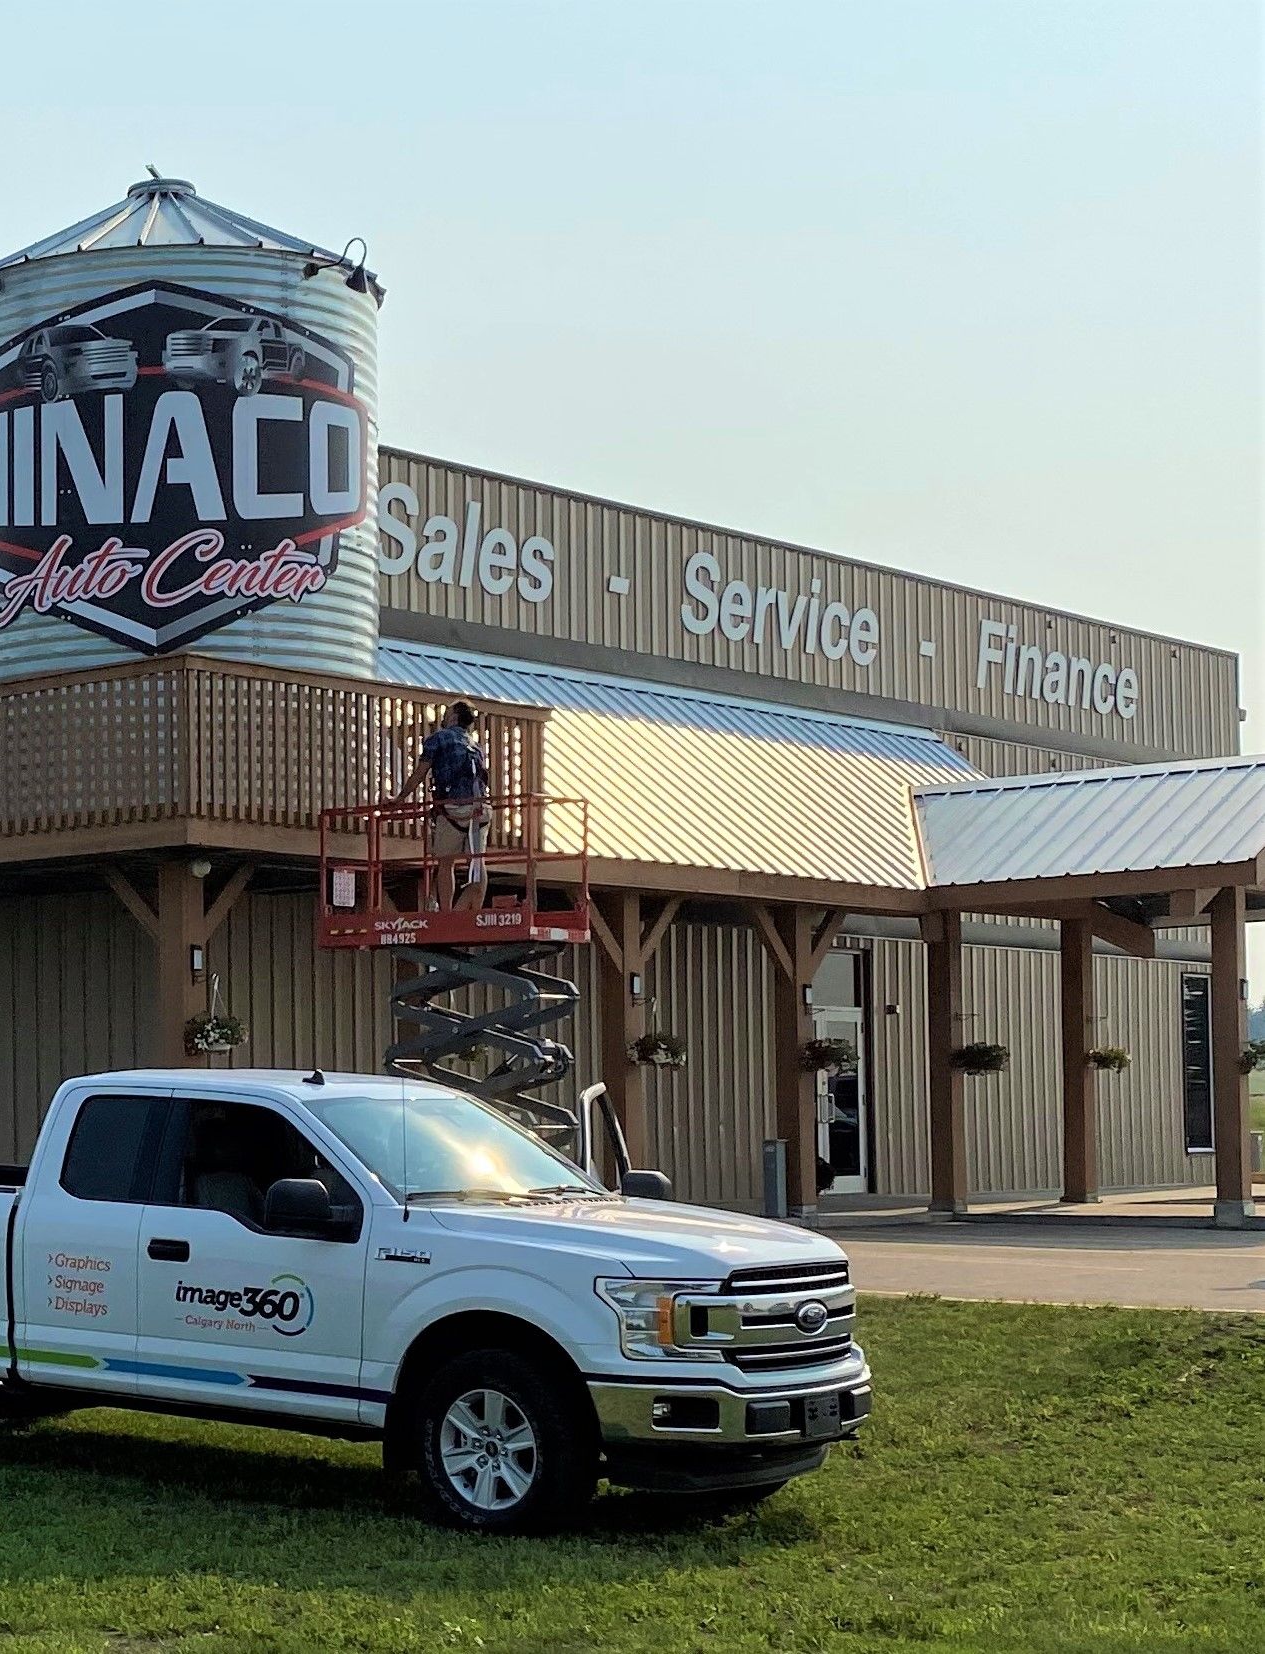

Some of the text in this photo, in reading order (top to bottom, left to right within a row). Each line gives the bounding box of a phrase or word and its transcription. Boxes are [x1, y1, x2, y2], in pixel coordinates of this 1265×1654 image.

[140, 528, 327, 608] Center
[378, 482, 555, 602] Sales
[680, 551, 880, 666] Service
[977, 618, 1139, 720] Finance
[374, 917, 429, 931] SKYJACK
[499, 913, 522, 926] 3219
[55, 1253, 111, 1272] Graphics
[54, 1275, 104, 1296] Signage
[54, 1296, 109, 1317] Displays
[175, 1280, 300, 1321] image360
[185, 1315, 256, 1332] Calgary North
